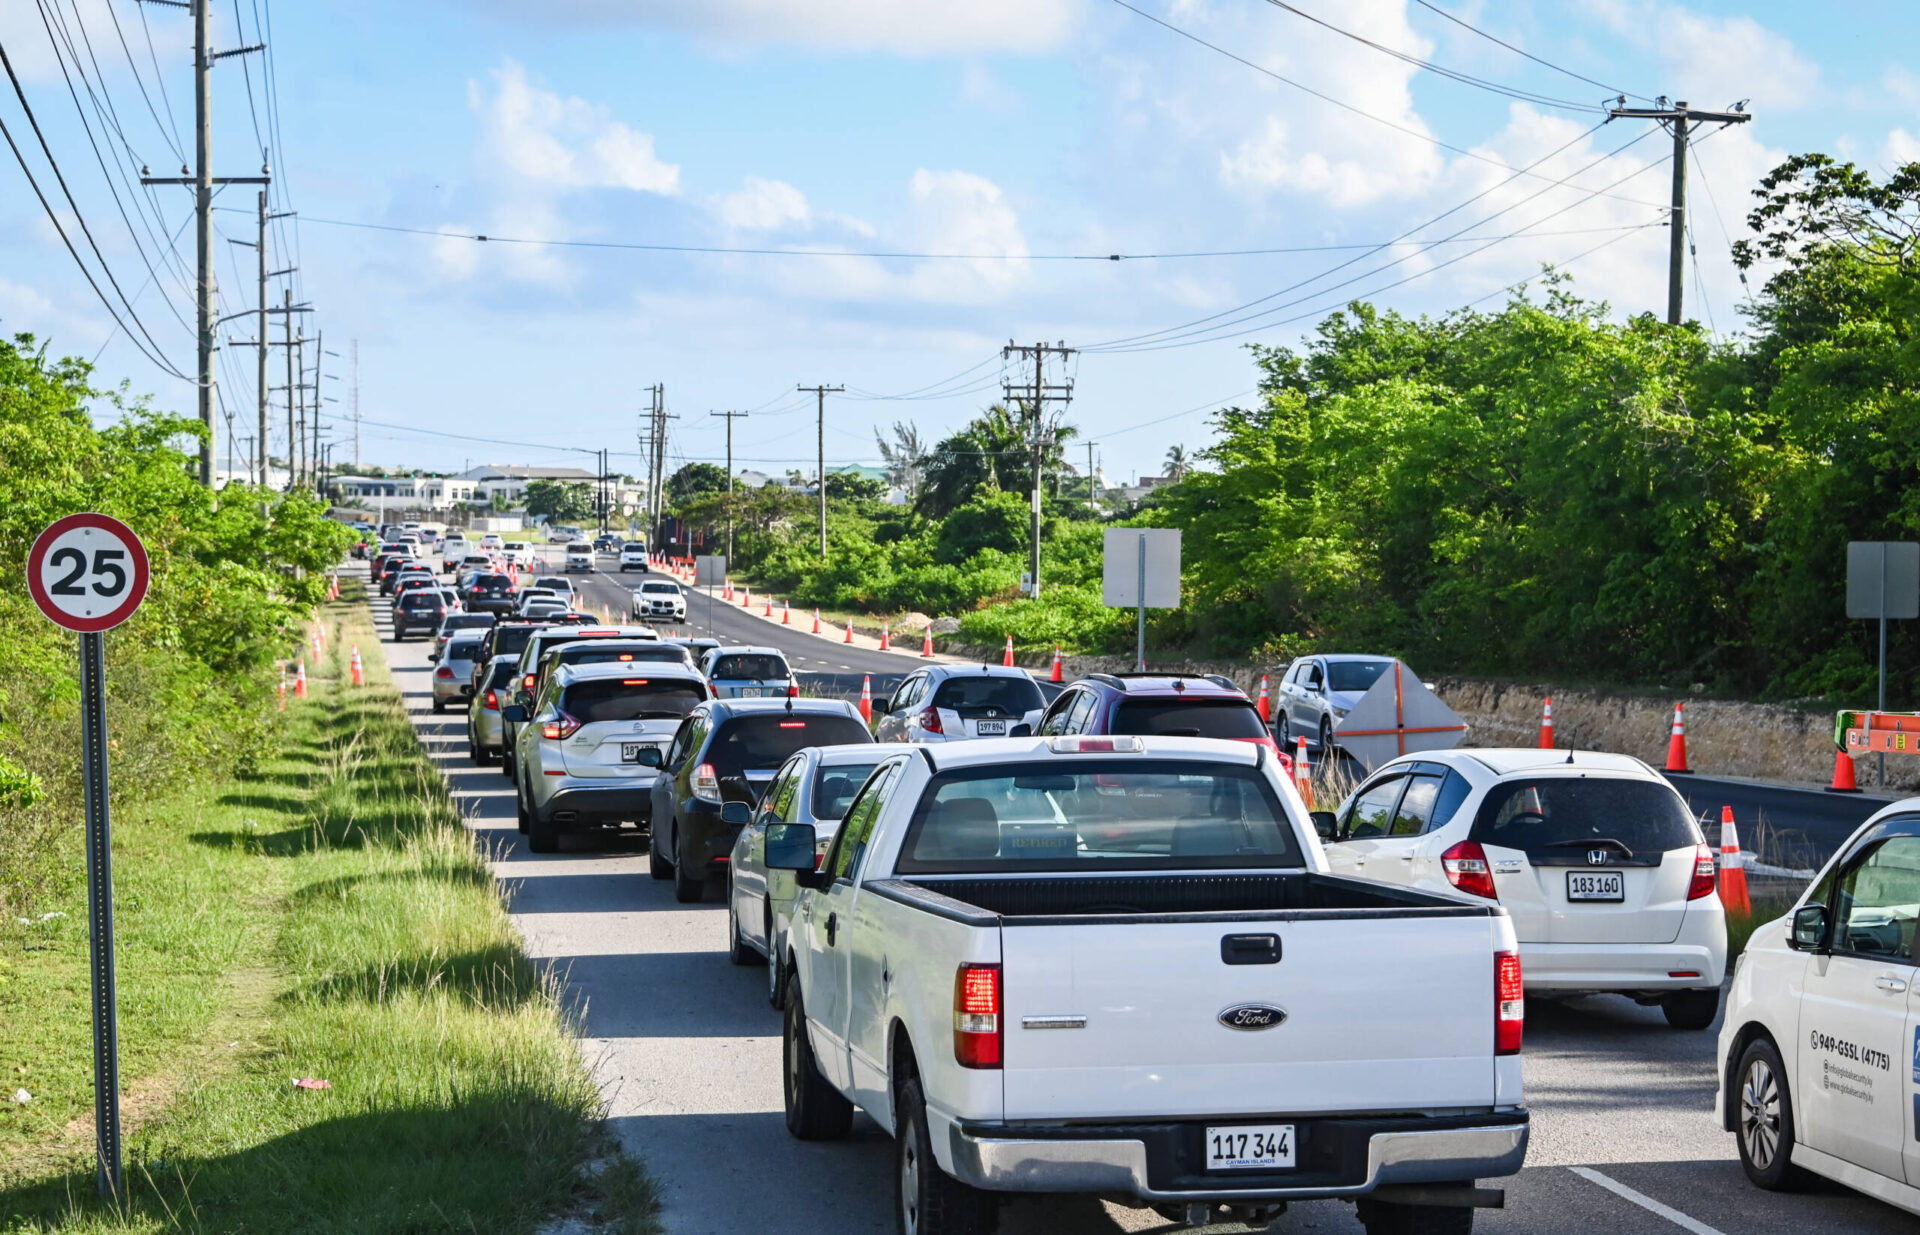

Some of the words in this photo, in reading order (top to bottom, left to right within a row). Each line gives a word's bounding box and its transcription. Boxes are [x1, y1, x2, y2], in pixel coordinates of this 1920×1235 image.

[50, 547, 126, 597] 25
[980, 723, 991, 731] 197
[992, 722, 1003, 731] 894
[1573, 877, 1594, 893] 183
[1597, 877, 1619, 893] 160
[1235, 1008, 1272, 1025] Ford
[1819, 1033, 1859, 1061] 949-GSSL
[1861, 1046, 1890, 1072] (4775)
[1213, 1134, 1249, 1160] 117
[1253, 1132, 1289, 1158] 344
